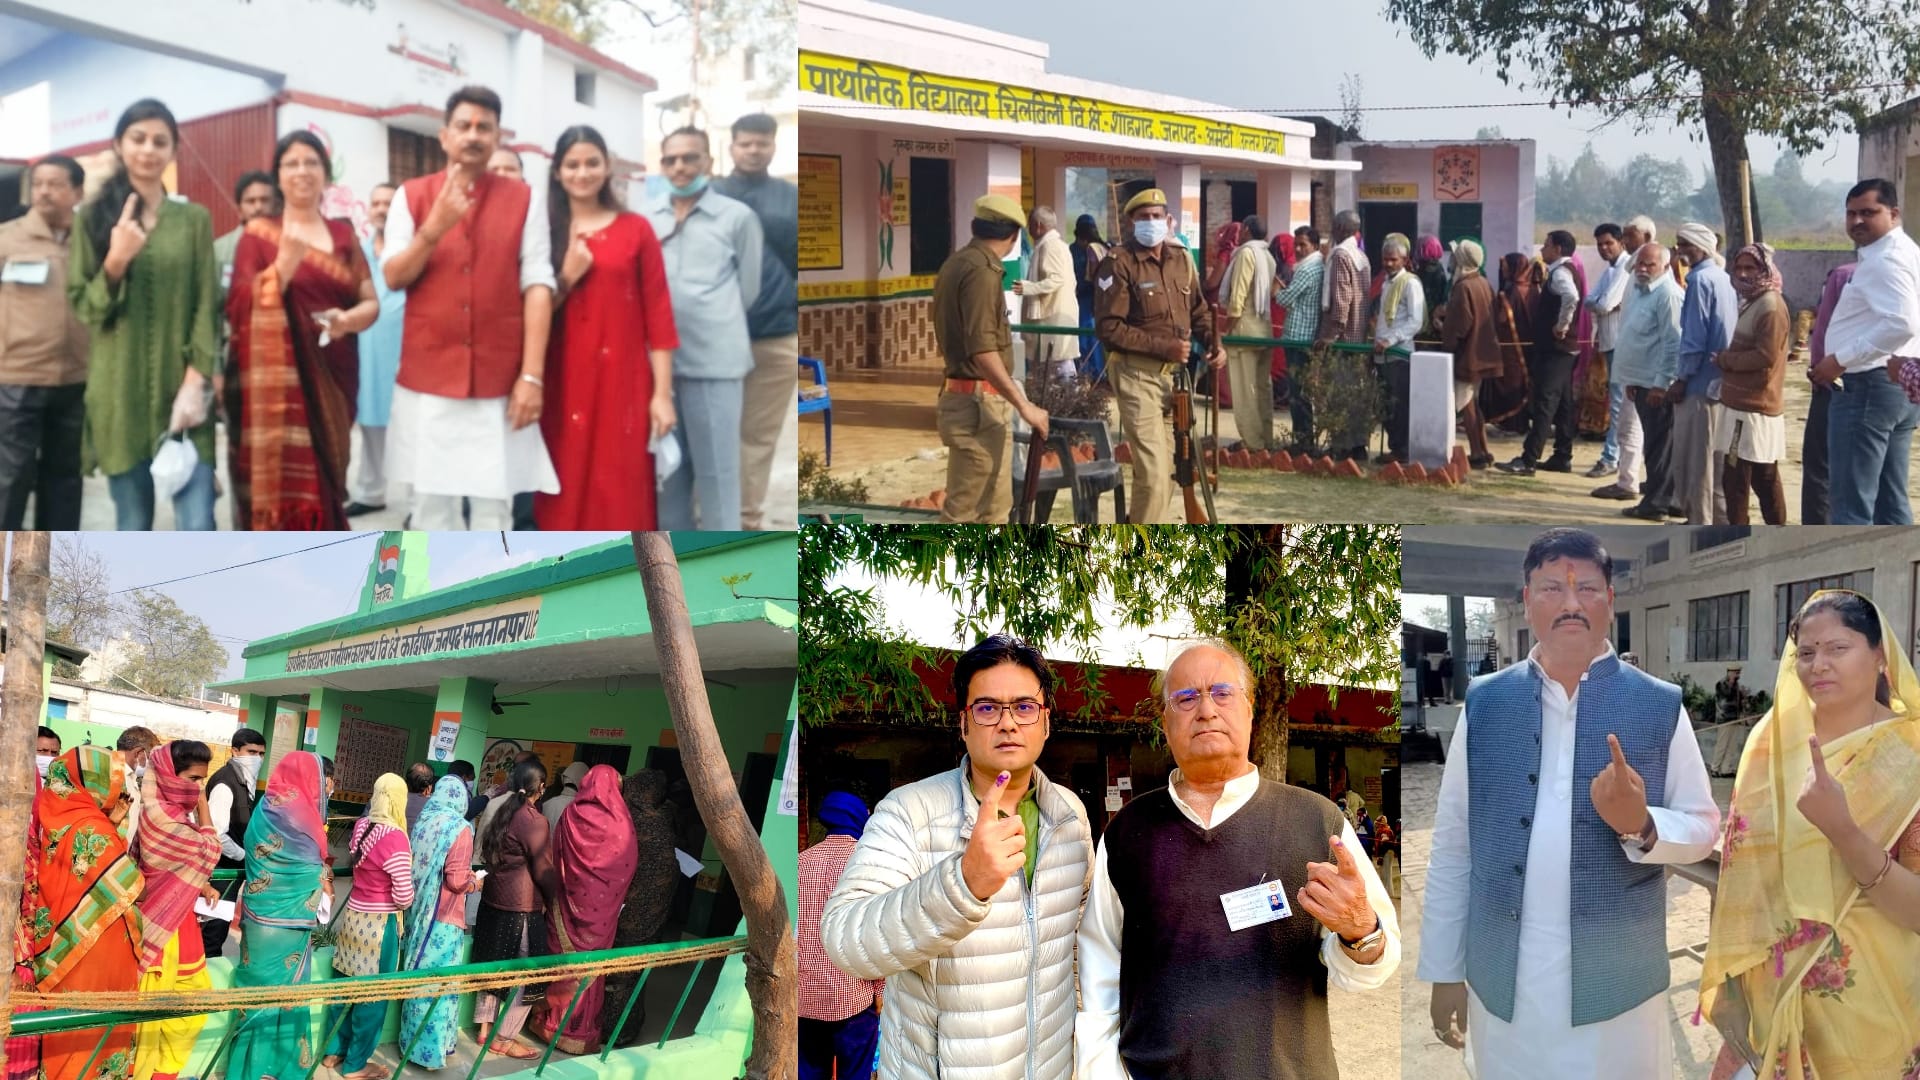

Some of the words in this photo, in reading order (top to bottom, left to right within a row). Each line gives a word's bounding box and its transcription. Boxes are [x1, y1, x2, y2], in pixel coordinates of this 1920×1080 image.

[804, 61, 903, 108] प्राथमिक
[908, 70, 990, 119] विद्यालय
[400, 625, 438, 657] कादीपर
[463, 611, 529, 649] सलतानपर
